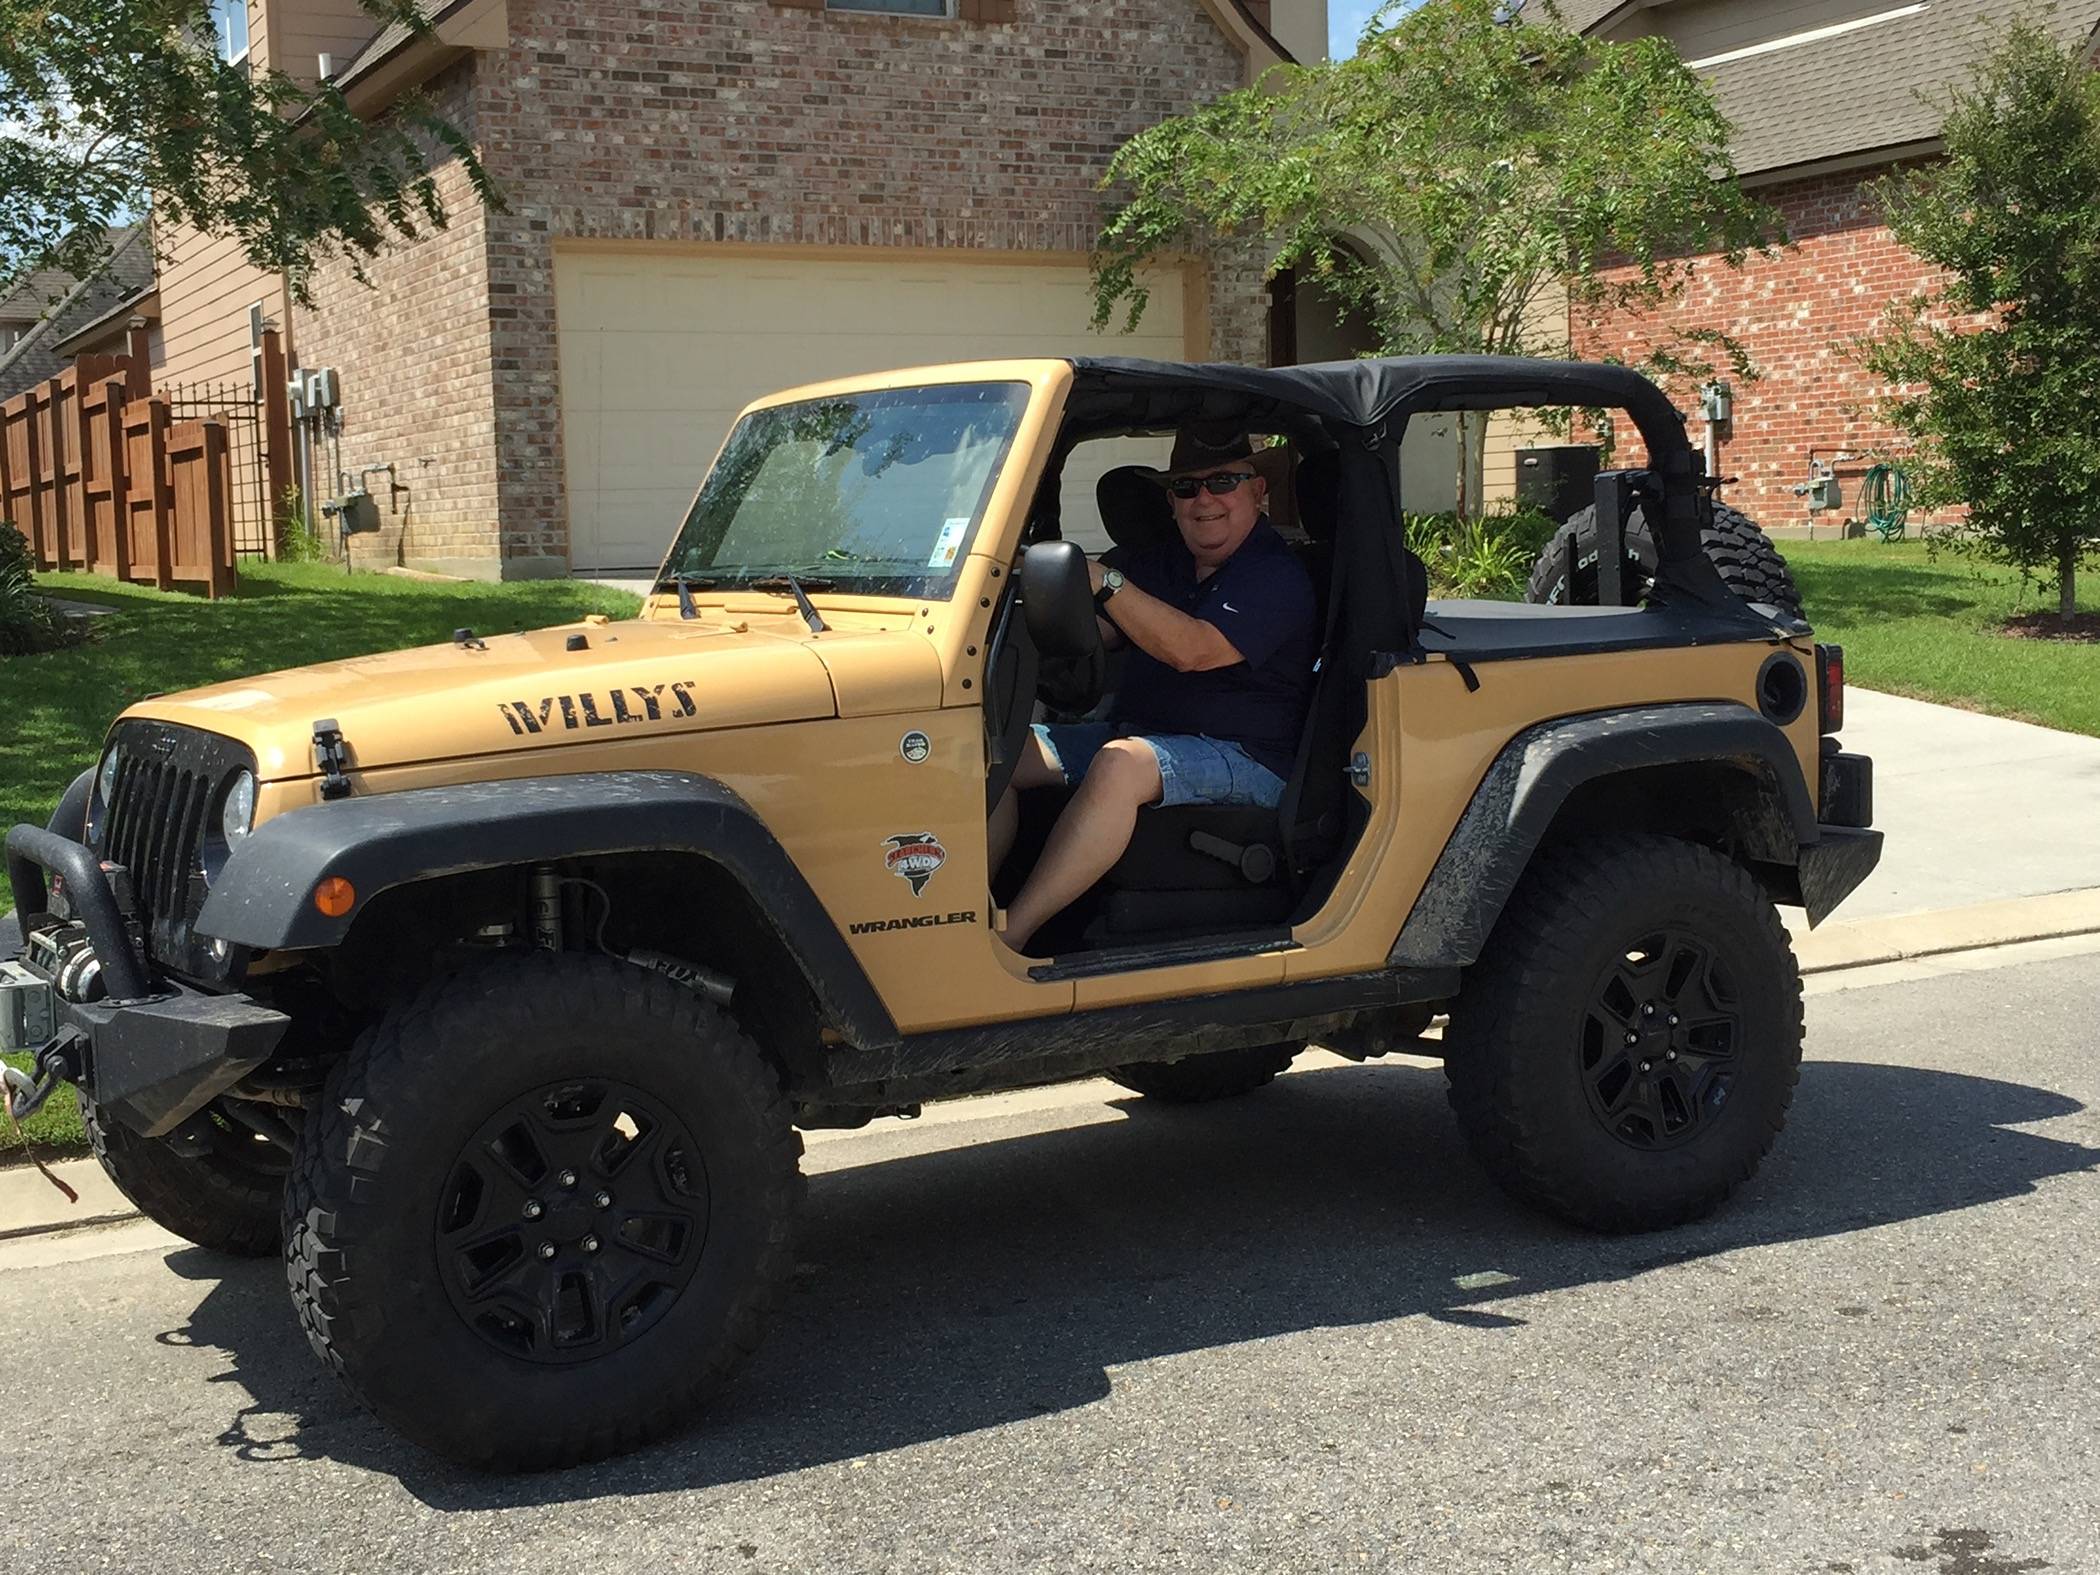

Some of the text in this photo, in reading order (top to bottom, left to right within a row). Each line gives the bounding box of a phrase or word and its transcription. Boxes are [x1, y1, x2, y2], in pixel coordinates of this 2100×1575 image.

[496, 681, 697, 735] WILLYS
[900, 855, 931, 869] 4WD
[849, 911, 977, 935] WRANGLER
